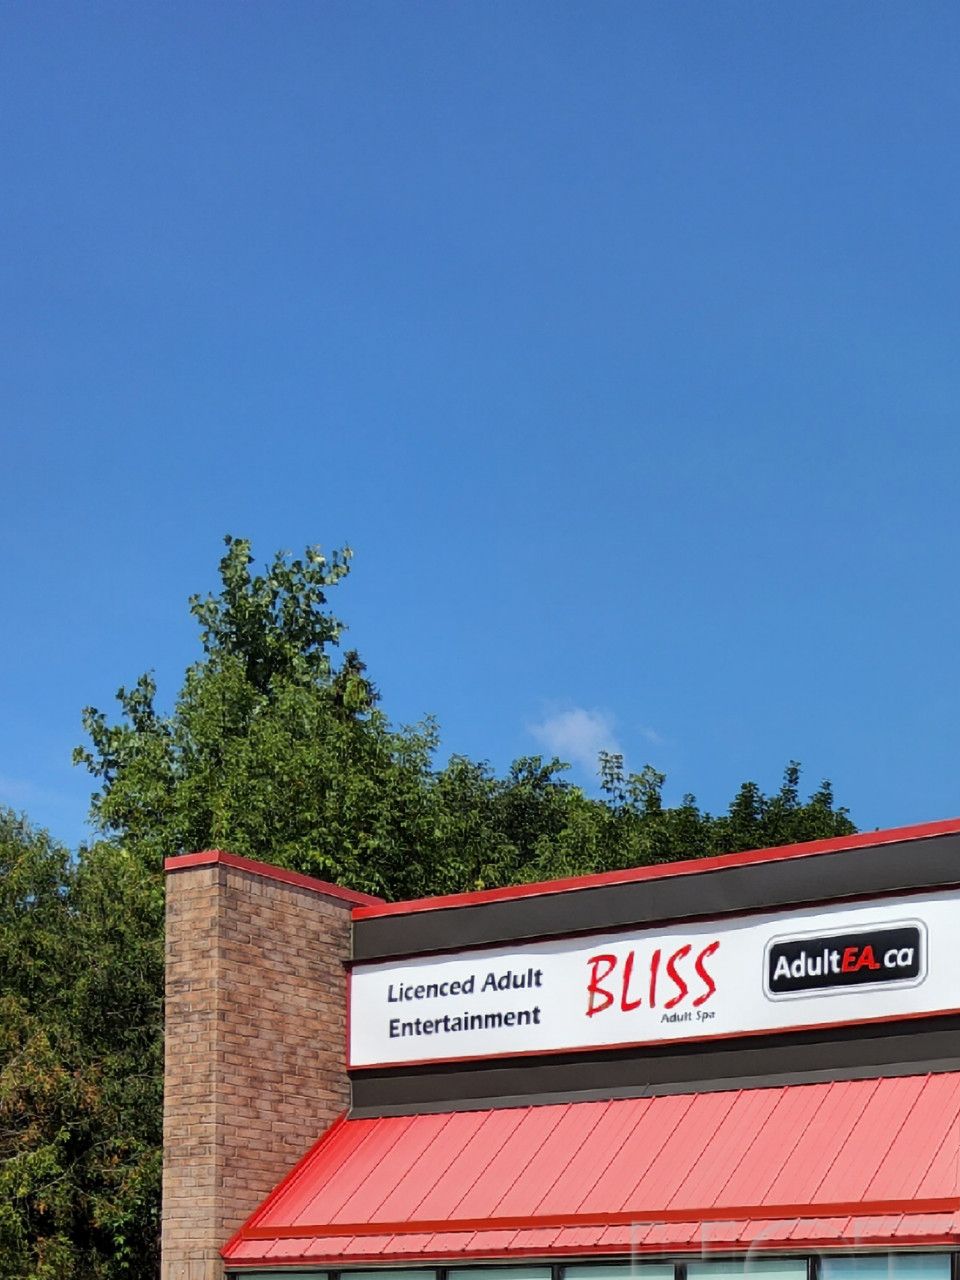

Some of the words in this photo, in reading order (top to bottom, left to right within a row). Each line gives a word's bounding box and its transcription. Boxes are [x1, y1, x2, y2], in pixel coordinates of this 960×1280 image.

[387, 975, 475, 1003] Licenced
[481, 968, 543, 993] Adult
[586, 941, 720, 1018] BLISS
[389, 1006, 541, 1038] Entertainment
[661, 1012, 692, 1023] Adult
[696, 1010, 715, 1022] Spa
